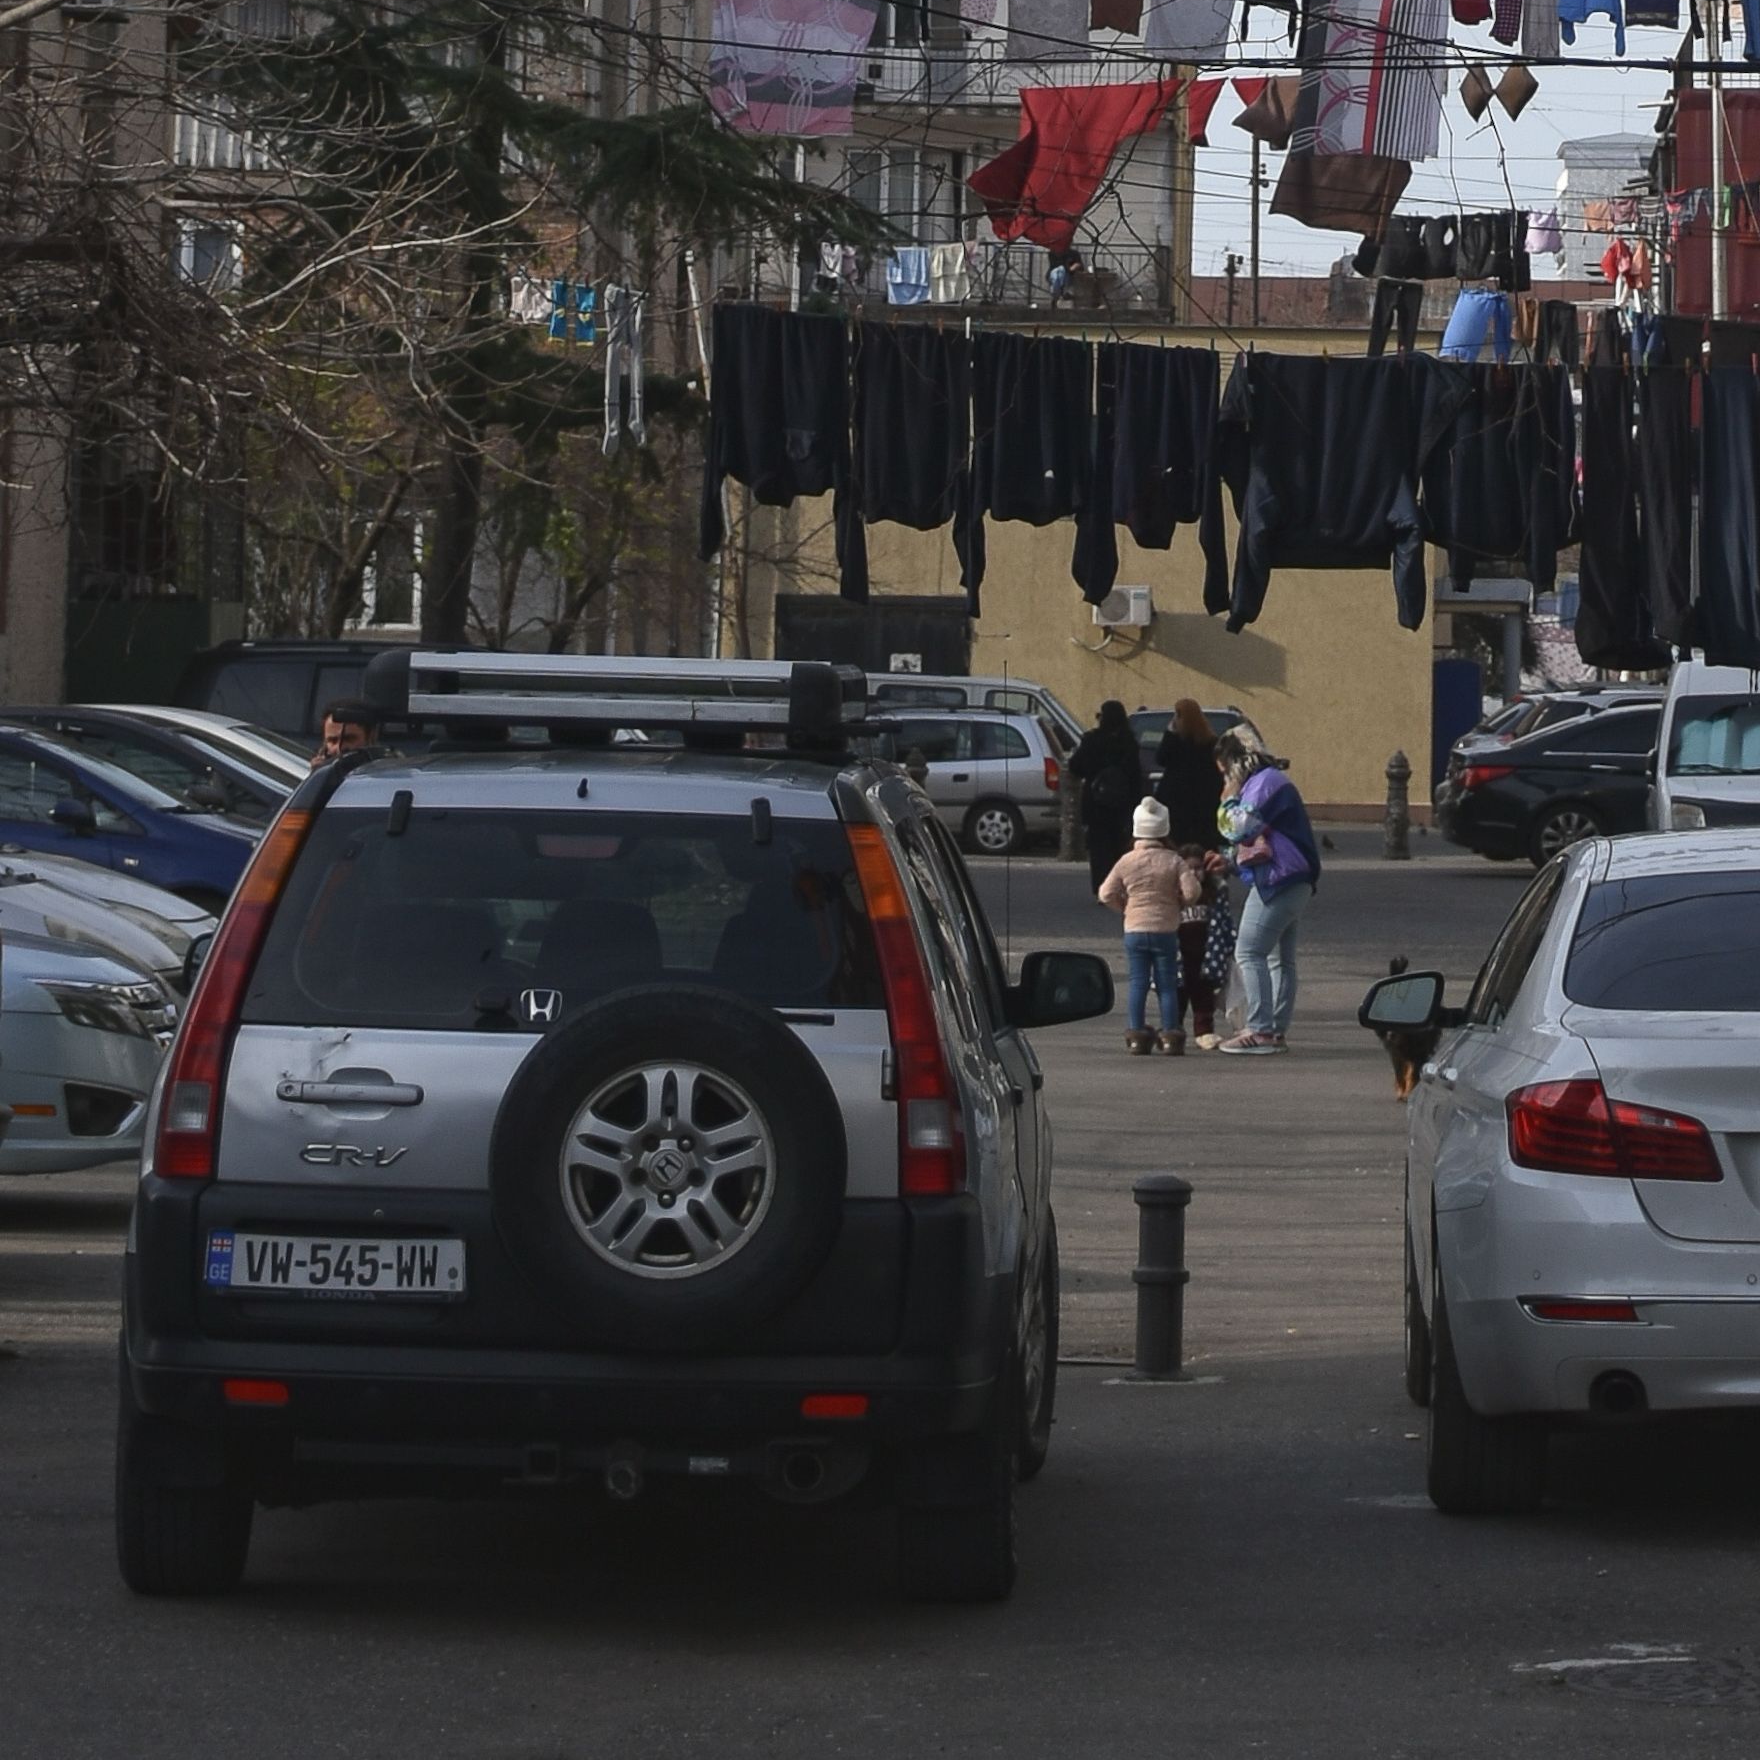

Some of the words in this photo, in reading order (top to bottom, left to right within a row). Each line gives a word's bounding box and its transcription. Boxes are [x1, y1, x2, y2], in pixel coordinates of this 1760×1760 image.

[300, 1143, 408, 1166] CR-V
[208, 1264, 229, 1280] GE
[245, 1240, 438, 1288] VW-545-WW
